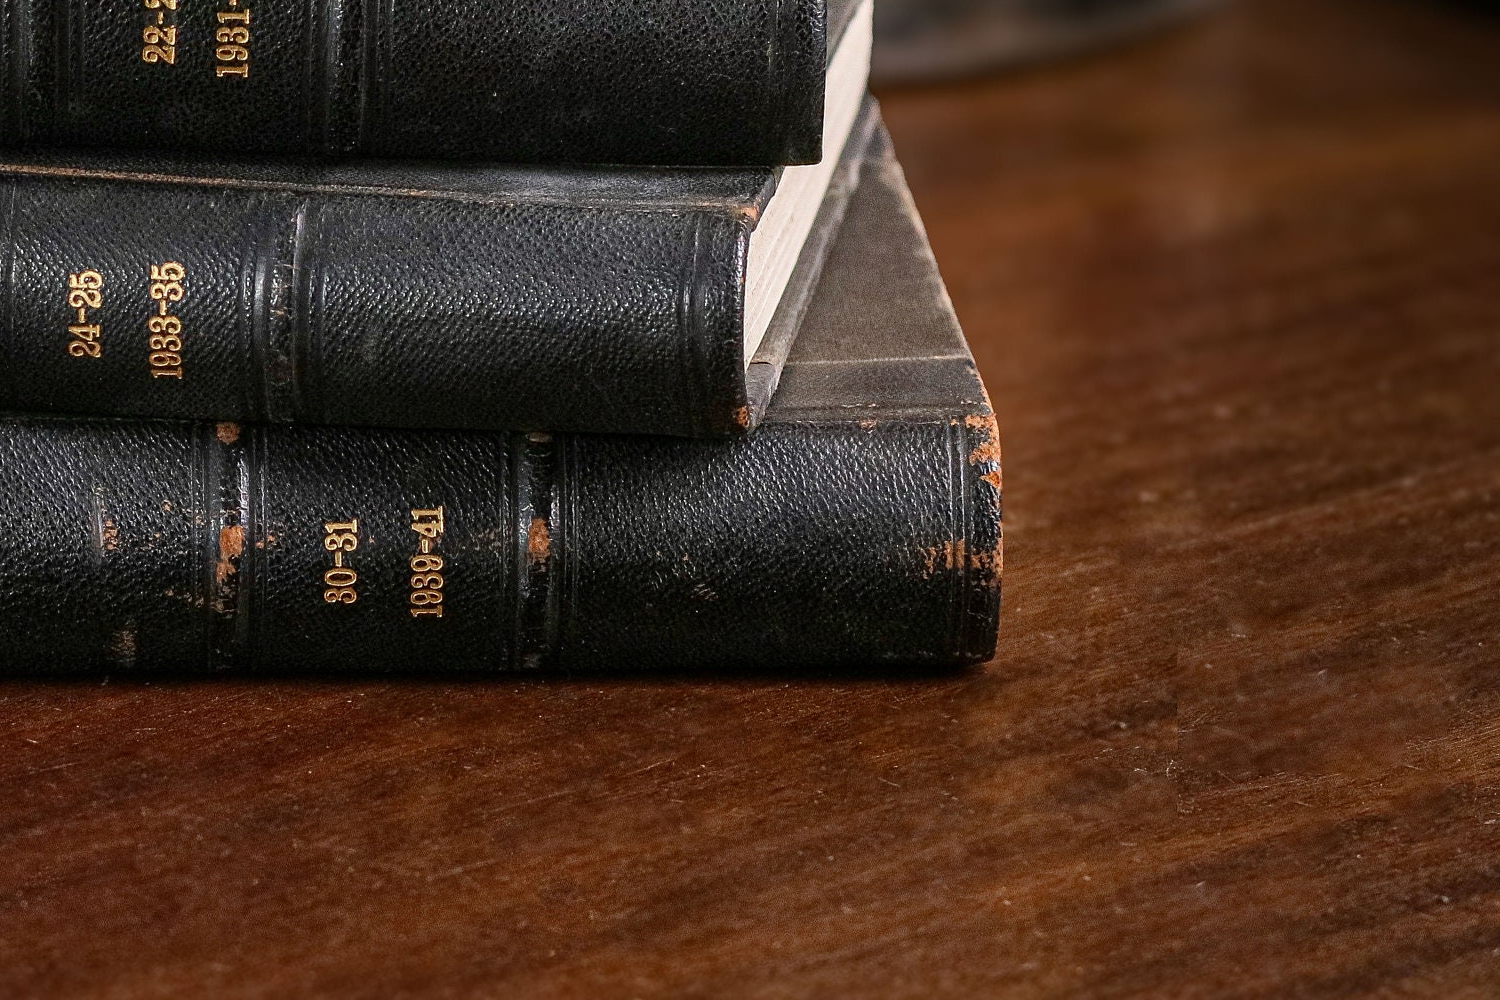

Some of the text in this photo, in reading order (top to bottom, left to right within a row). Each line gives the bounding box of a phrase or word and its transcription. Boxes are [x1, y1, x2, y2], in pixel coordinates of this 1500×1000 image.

[68, 269, 103, 357] 24-25
[148, 261, 186, 378] 1933-35
[325, 519, 358, 603] 30-31
[410, 507, 445, 616] 1939-41
